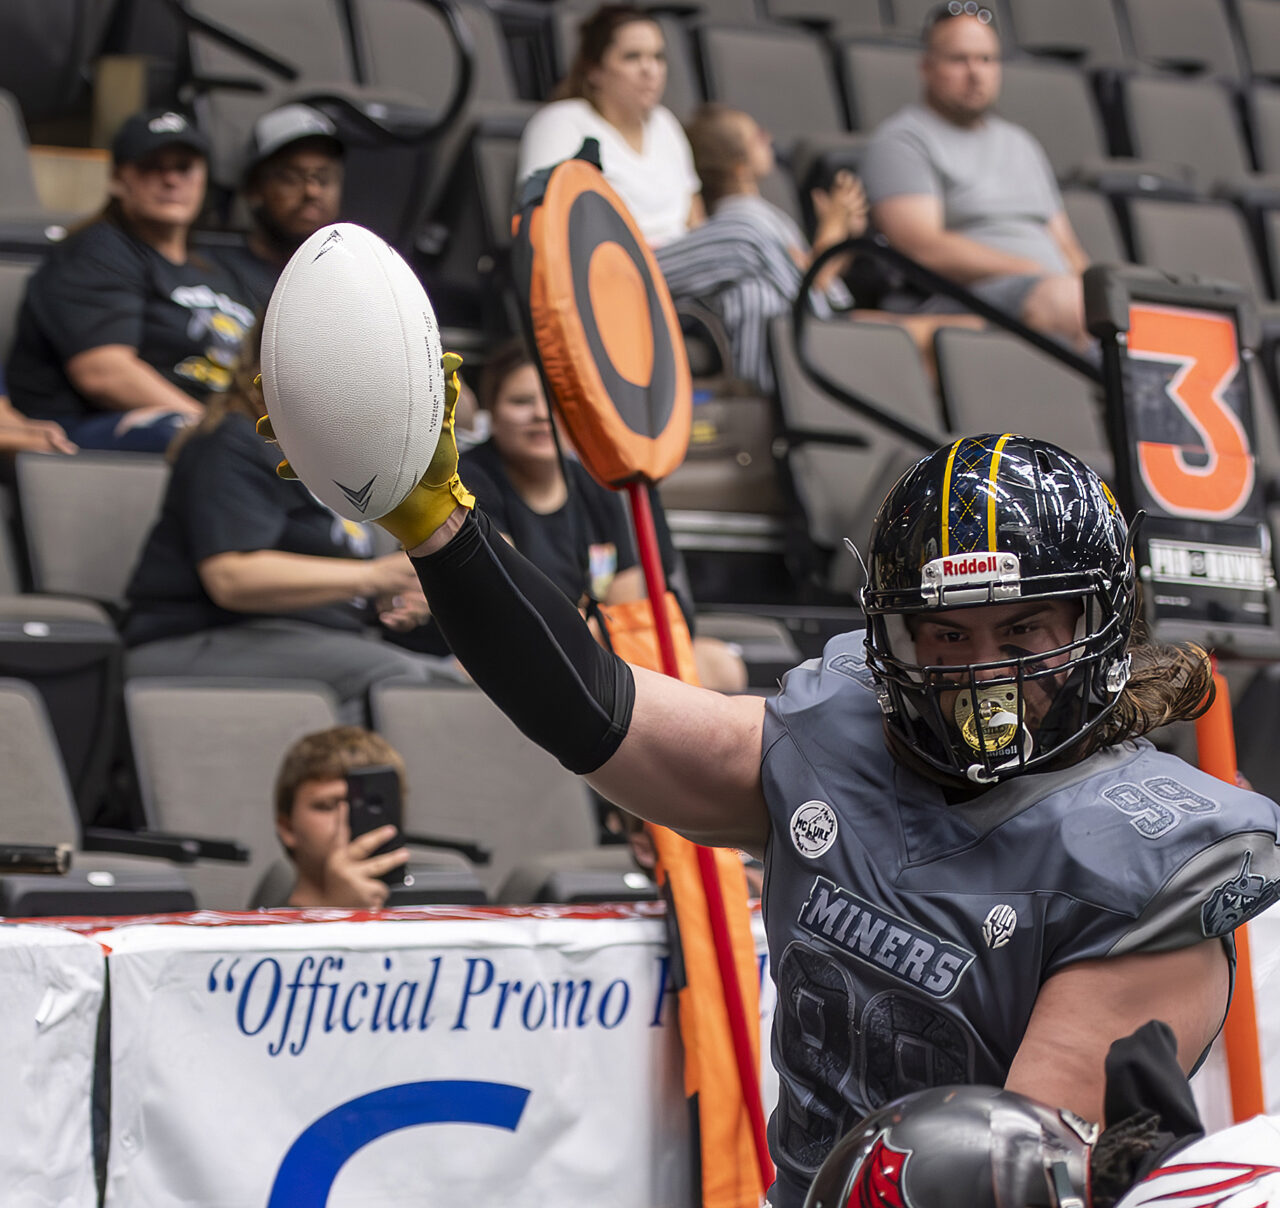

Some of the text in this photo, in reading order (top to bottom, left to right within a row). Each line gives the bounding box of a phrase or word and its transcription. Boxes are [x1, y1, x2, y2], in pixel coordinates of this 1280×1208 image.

[1127, 304, 1255, 522] 3
[942, 556, 998, 577] Riddell
[1102, 776, 1222, 840] 99
[806, 887, 964, 994] MINERS
[206, 956, 444, 1057] “Official
[450, 957, 632, 1032] Promo
